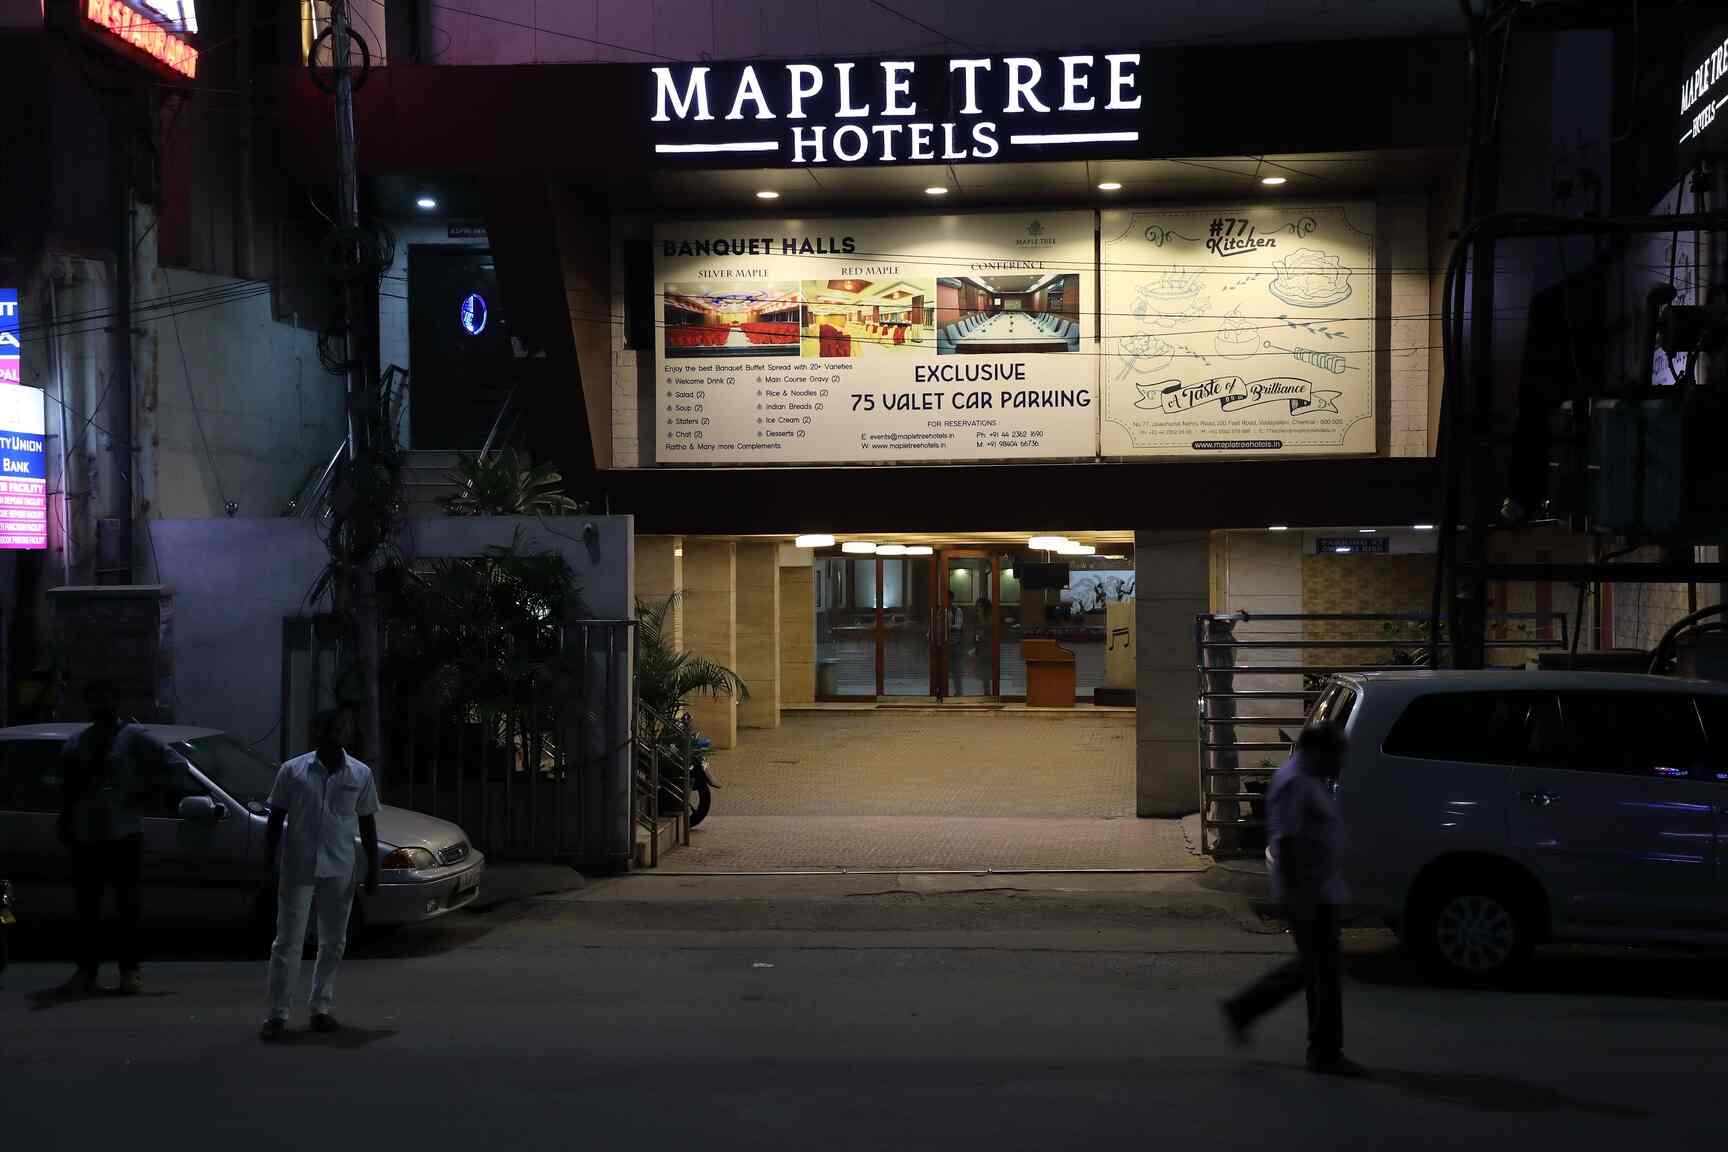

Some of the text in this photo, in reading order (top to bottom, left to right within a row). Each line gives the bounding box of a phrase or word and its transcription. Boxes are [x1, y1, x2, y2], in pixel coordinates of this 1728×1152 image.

[651, 53, 1142, 121] MAPLE TREE
[1680, 58, 1710, 115] MAPLE
[1692, 100, 1716, 138] HOTELS
[790, 121, 999, 162] HOTELS
[1209, 218, 1249, 237] #77
[663, 236, 856, 257] BANQUET HALLS
[1206, 226, 1276, 257] Kitchen
[698, 268, 769, 279] SILVER MAPLE
[841, 264, 900, 276] RED MAPLE
[971, 260, 1046, 271] CONFERENCE
[707, 377, 725, 385] Drink
[765, 375, 782, 383] Main
[784, 375, 807, 383] Course
[915, 363, 1026, 382] EXCLUSIVE
[674, 391, 694, 399] Salad
[765, 390, 781, 398] Rice
[851, 394, 875, 411] 75
[952, 391, 992, 410] CAR
[1000, 389, 1091, 408] PARKING
[1182, 379, 1222, 407] Taste
[1250, 383, 1306, 401] Brilliance
[765, 416, 776, 424] Ice
[778, 416, 800, 424] Cream
[928, 420, 942, 428] FOR
